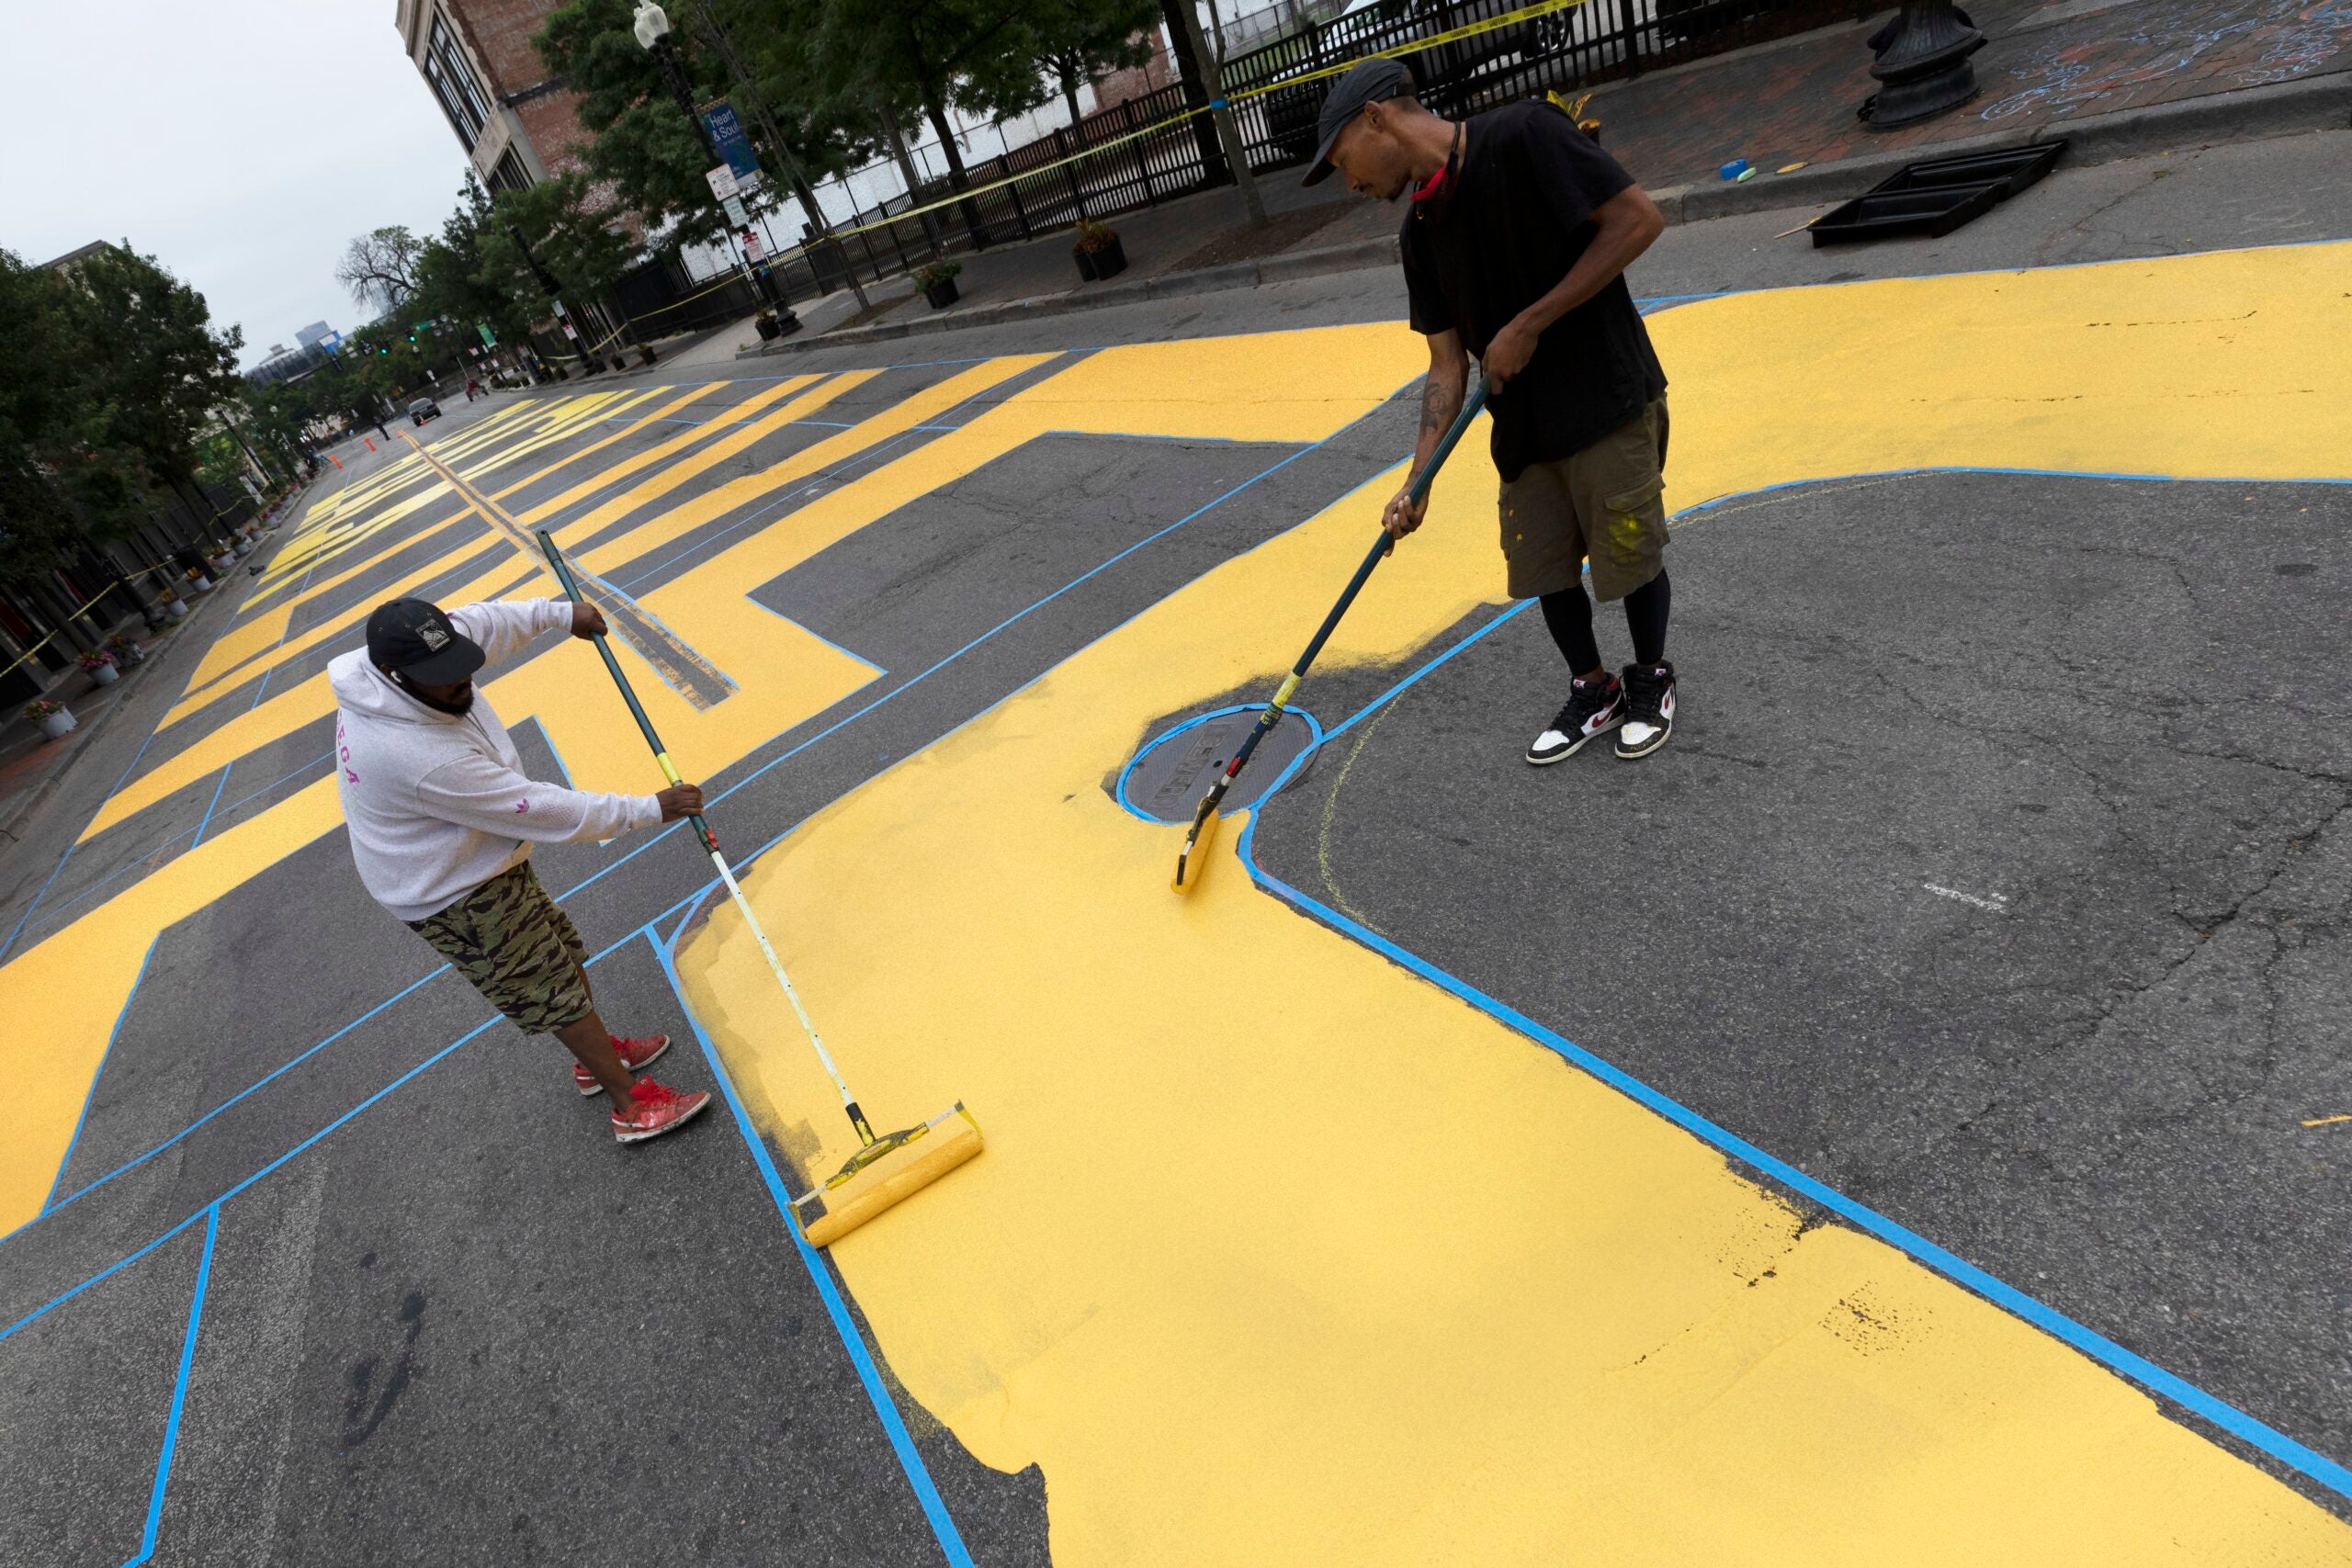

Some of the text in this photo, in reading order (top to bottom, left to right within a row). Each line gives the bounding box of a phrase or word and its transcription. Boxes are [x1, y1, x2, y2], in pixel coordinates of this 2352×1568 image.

[709, 109, 734, 130] Heart
[712, 130, 721, 141] &
[718, 120, 740, 139] Soul
